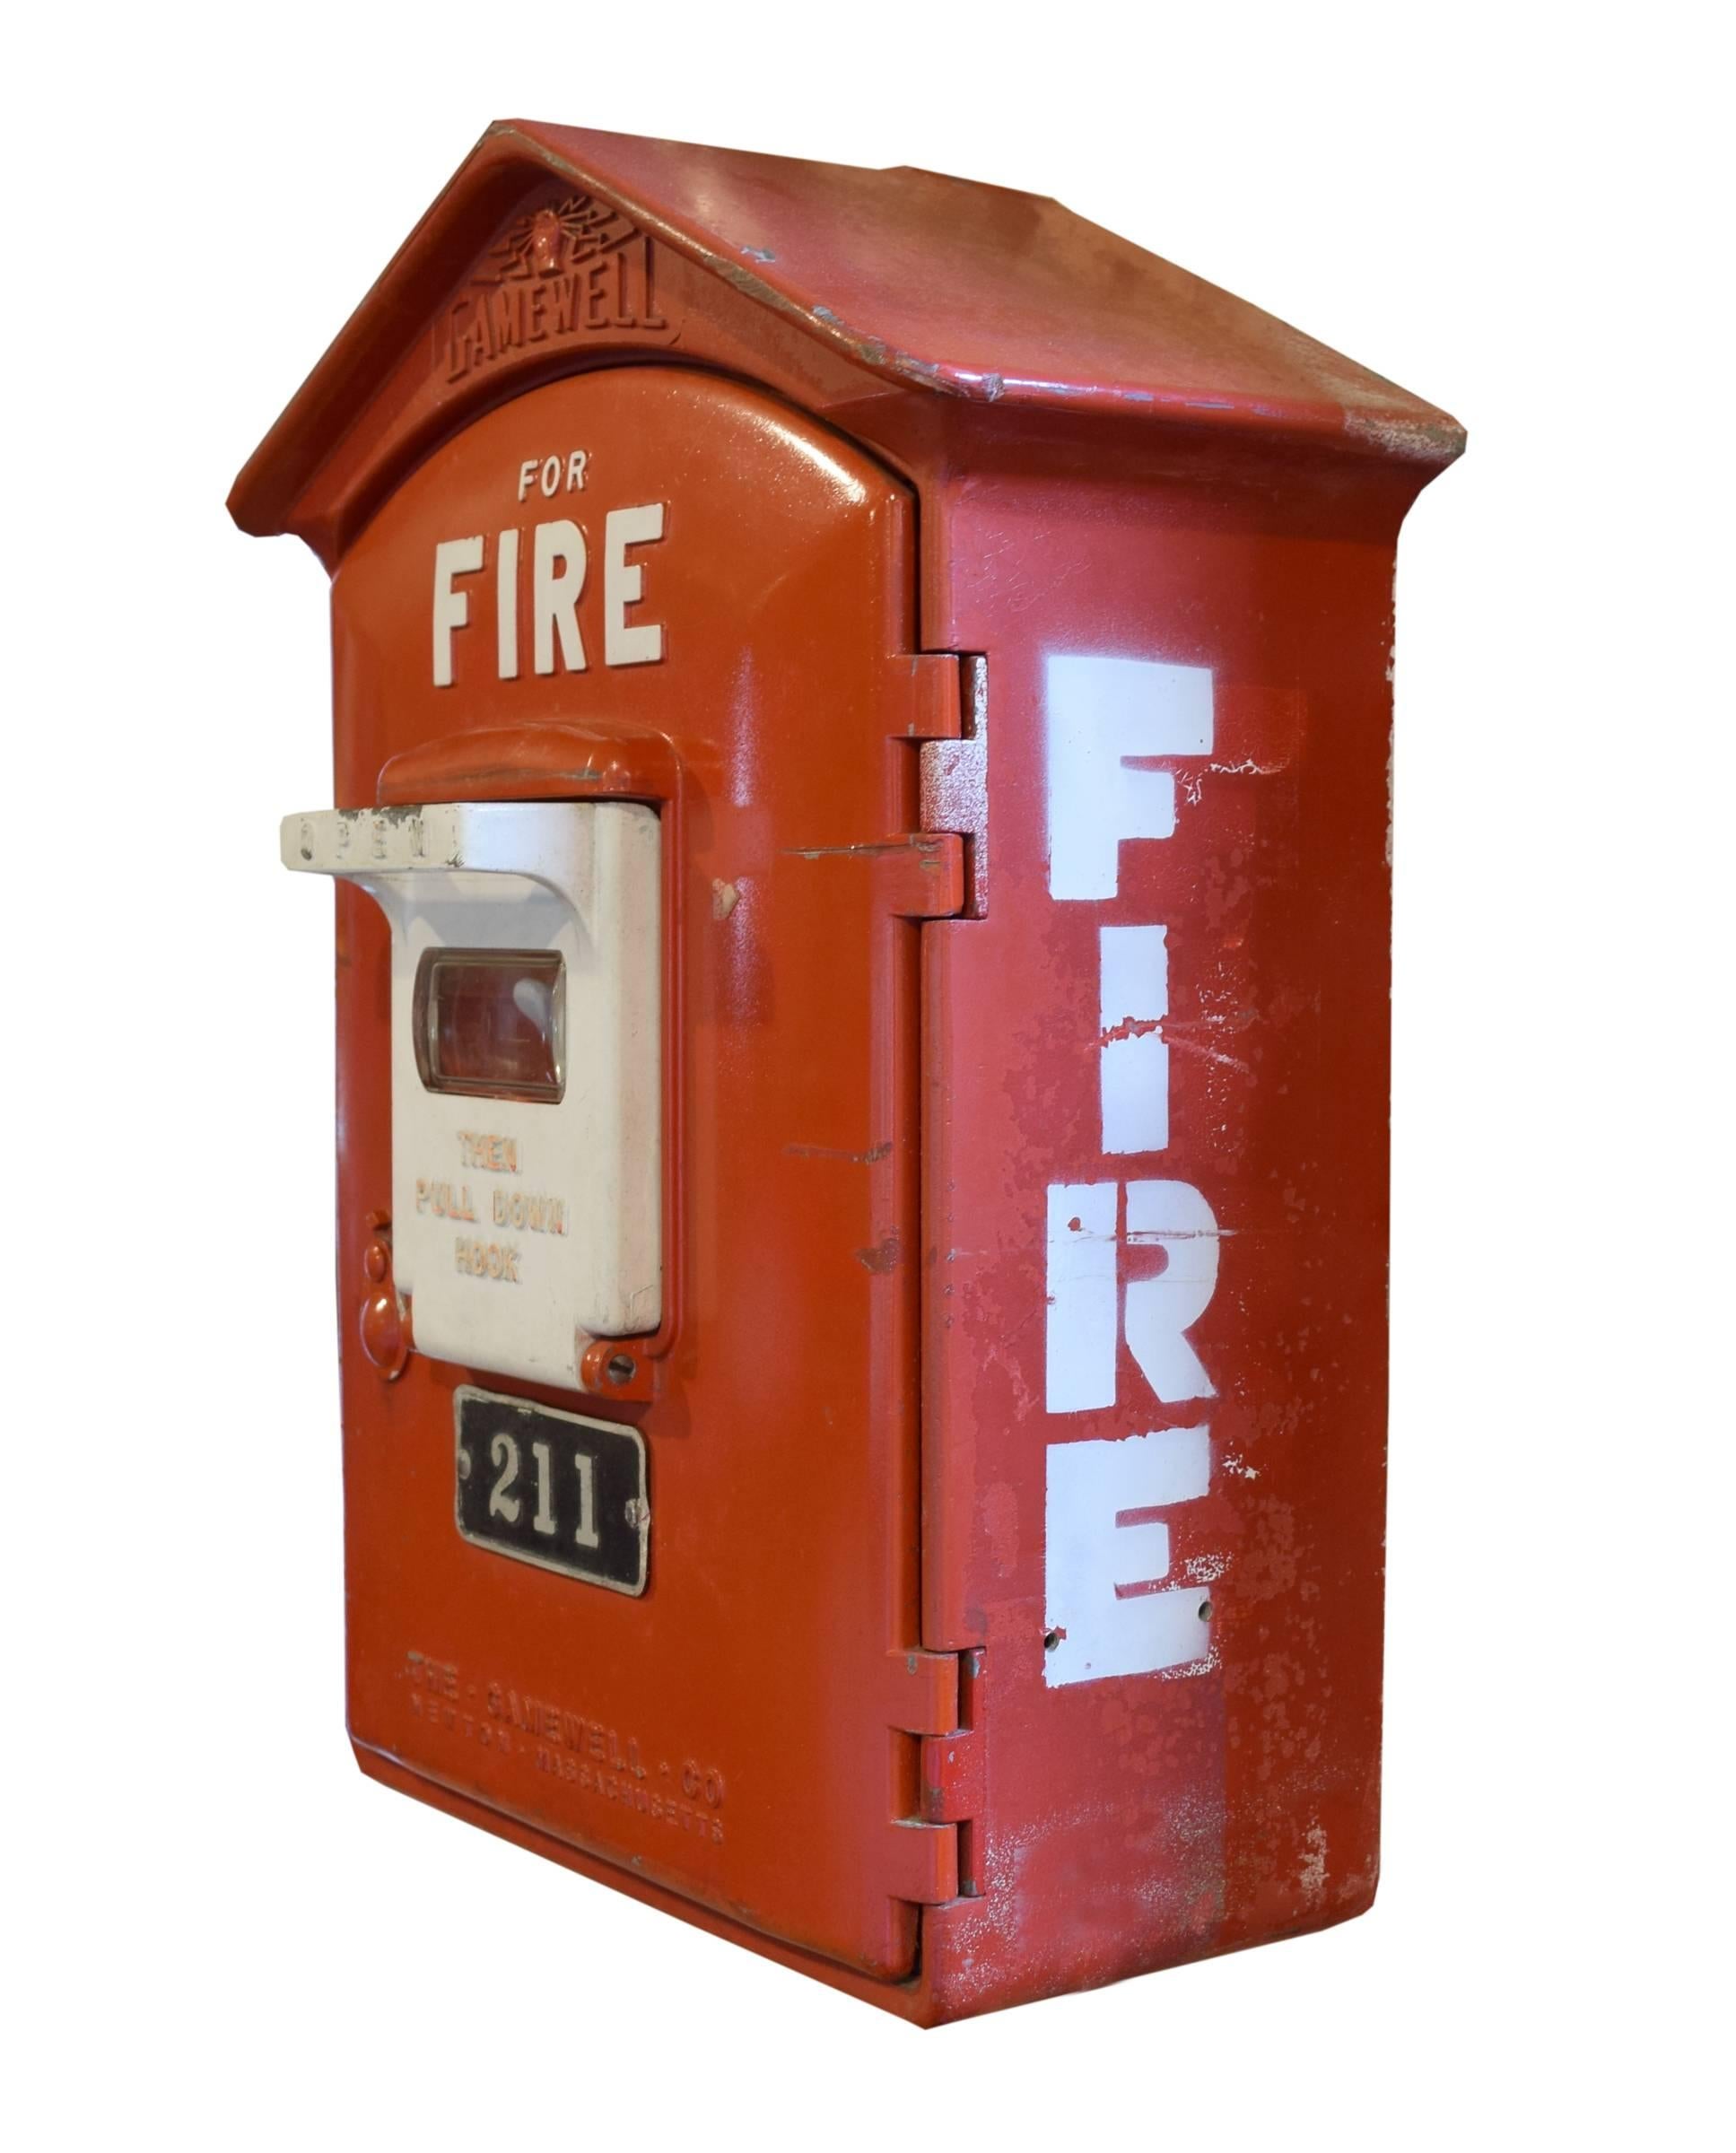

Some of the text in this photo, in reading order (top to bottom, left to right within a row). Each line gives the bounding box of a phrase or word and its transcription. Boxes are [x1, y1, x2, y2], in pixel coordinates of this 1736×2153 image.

[447, 235, 669, 384] GAMEWELL
[518, 449, 588, 501] FOR
[432, 502, 664, 687] FIRE
[415, 1177, 569, 1236] PULL DOWN
[458, 1129, 522, 1175] THEN
[1043, 655, 1221, 1687] FIRE
[455, 1235, 522, 1285] HOOK
[489, 1433, 599, 1549] 211
[406, 1650, 726, 1809] THE GAMEWELL CO
[410, 1693, 724, 1844] NEWTON MASSACHUSETTS
